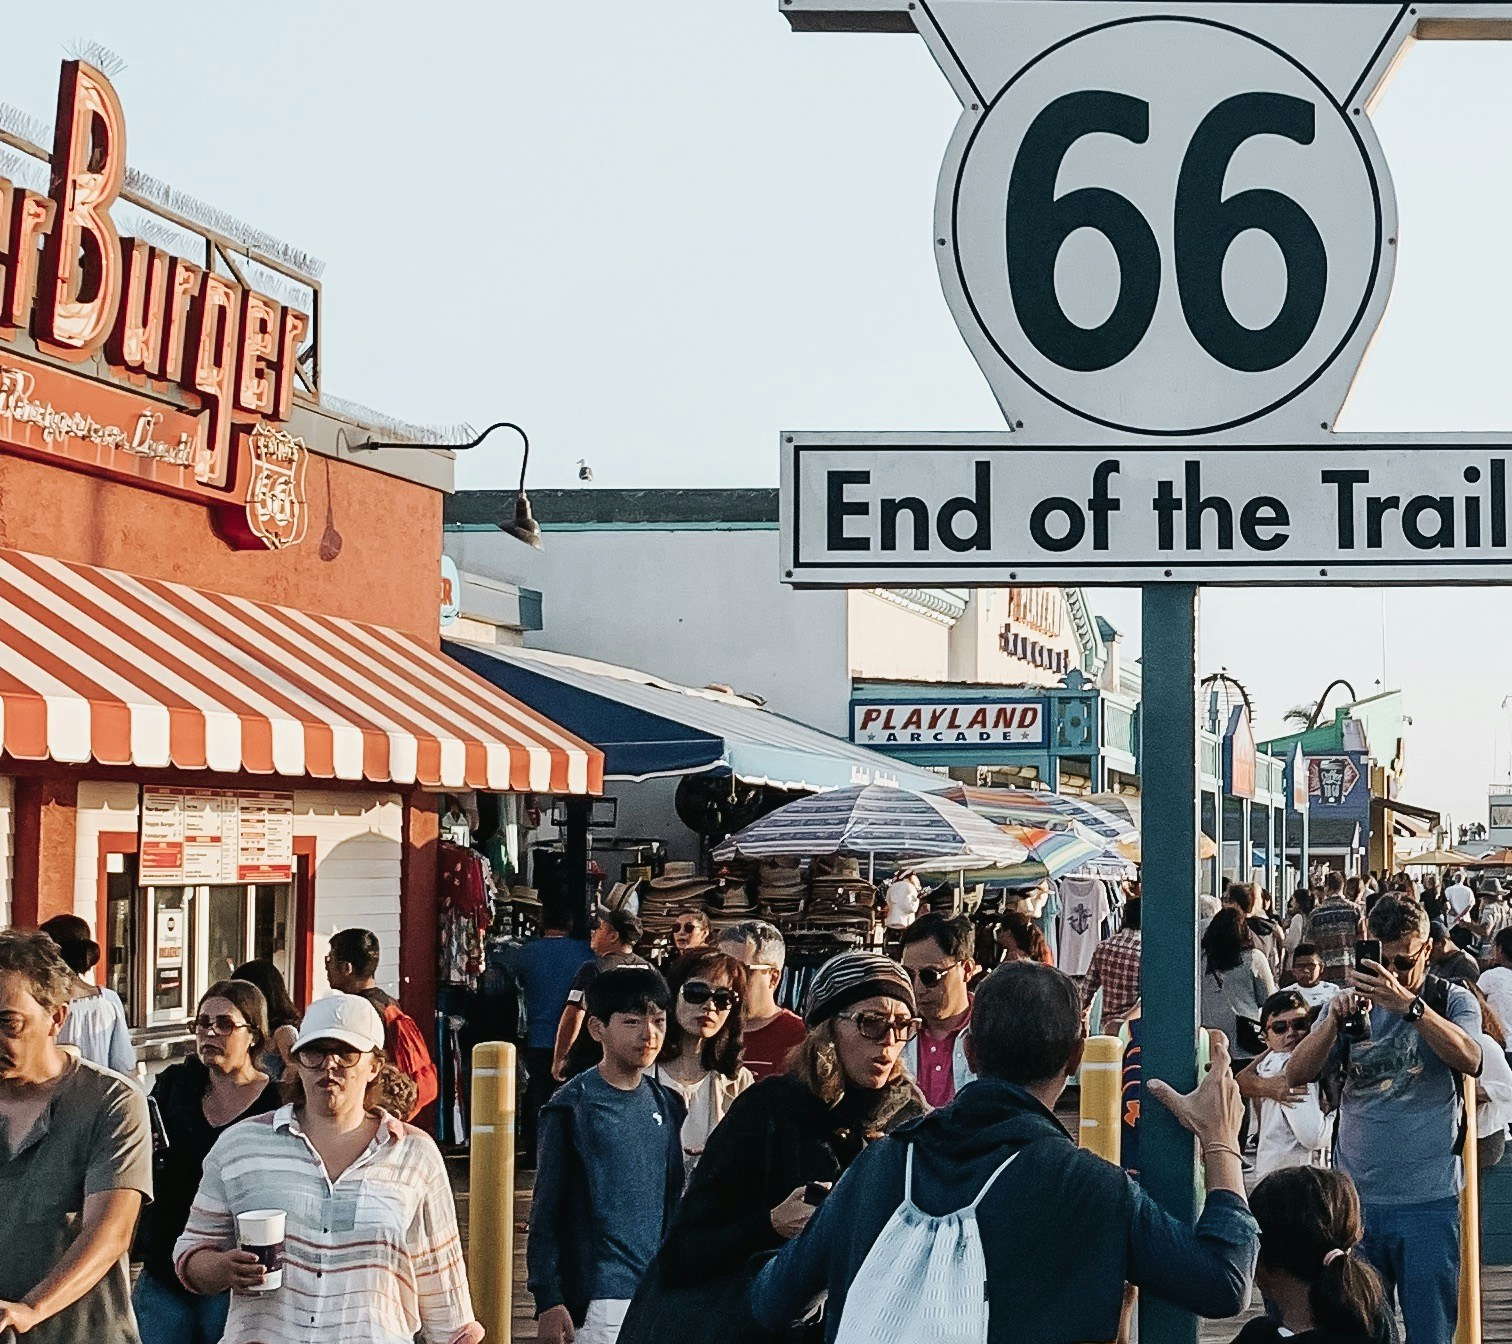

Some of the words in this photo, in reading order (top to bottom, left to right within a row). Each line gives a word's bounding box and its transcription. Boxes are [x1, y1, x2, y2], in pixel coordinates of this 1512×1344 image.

[36, 59, 309, 494] Burger
[1006, 90, 1328, 373] 66
[827, 460, 992, 552] End
[1030, 459, 1121, 553] of
[1153, 460, 1291, 552] the
[1321, 458, 1507, 550] Trail
[859, 707, 1039, 731] PLAYLAND
[886, 731, 1012, 743] ARCADE
